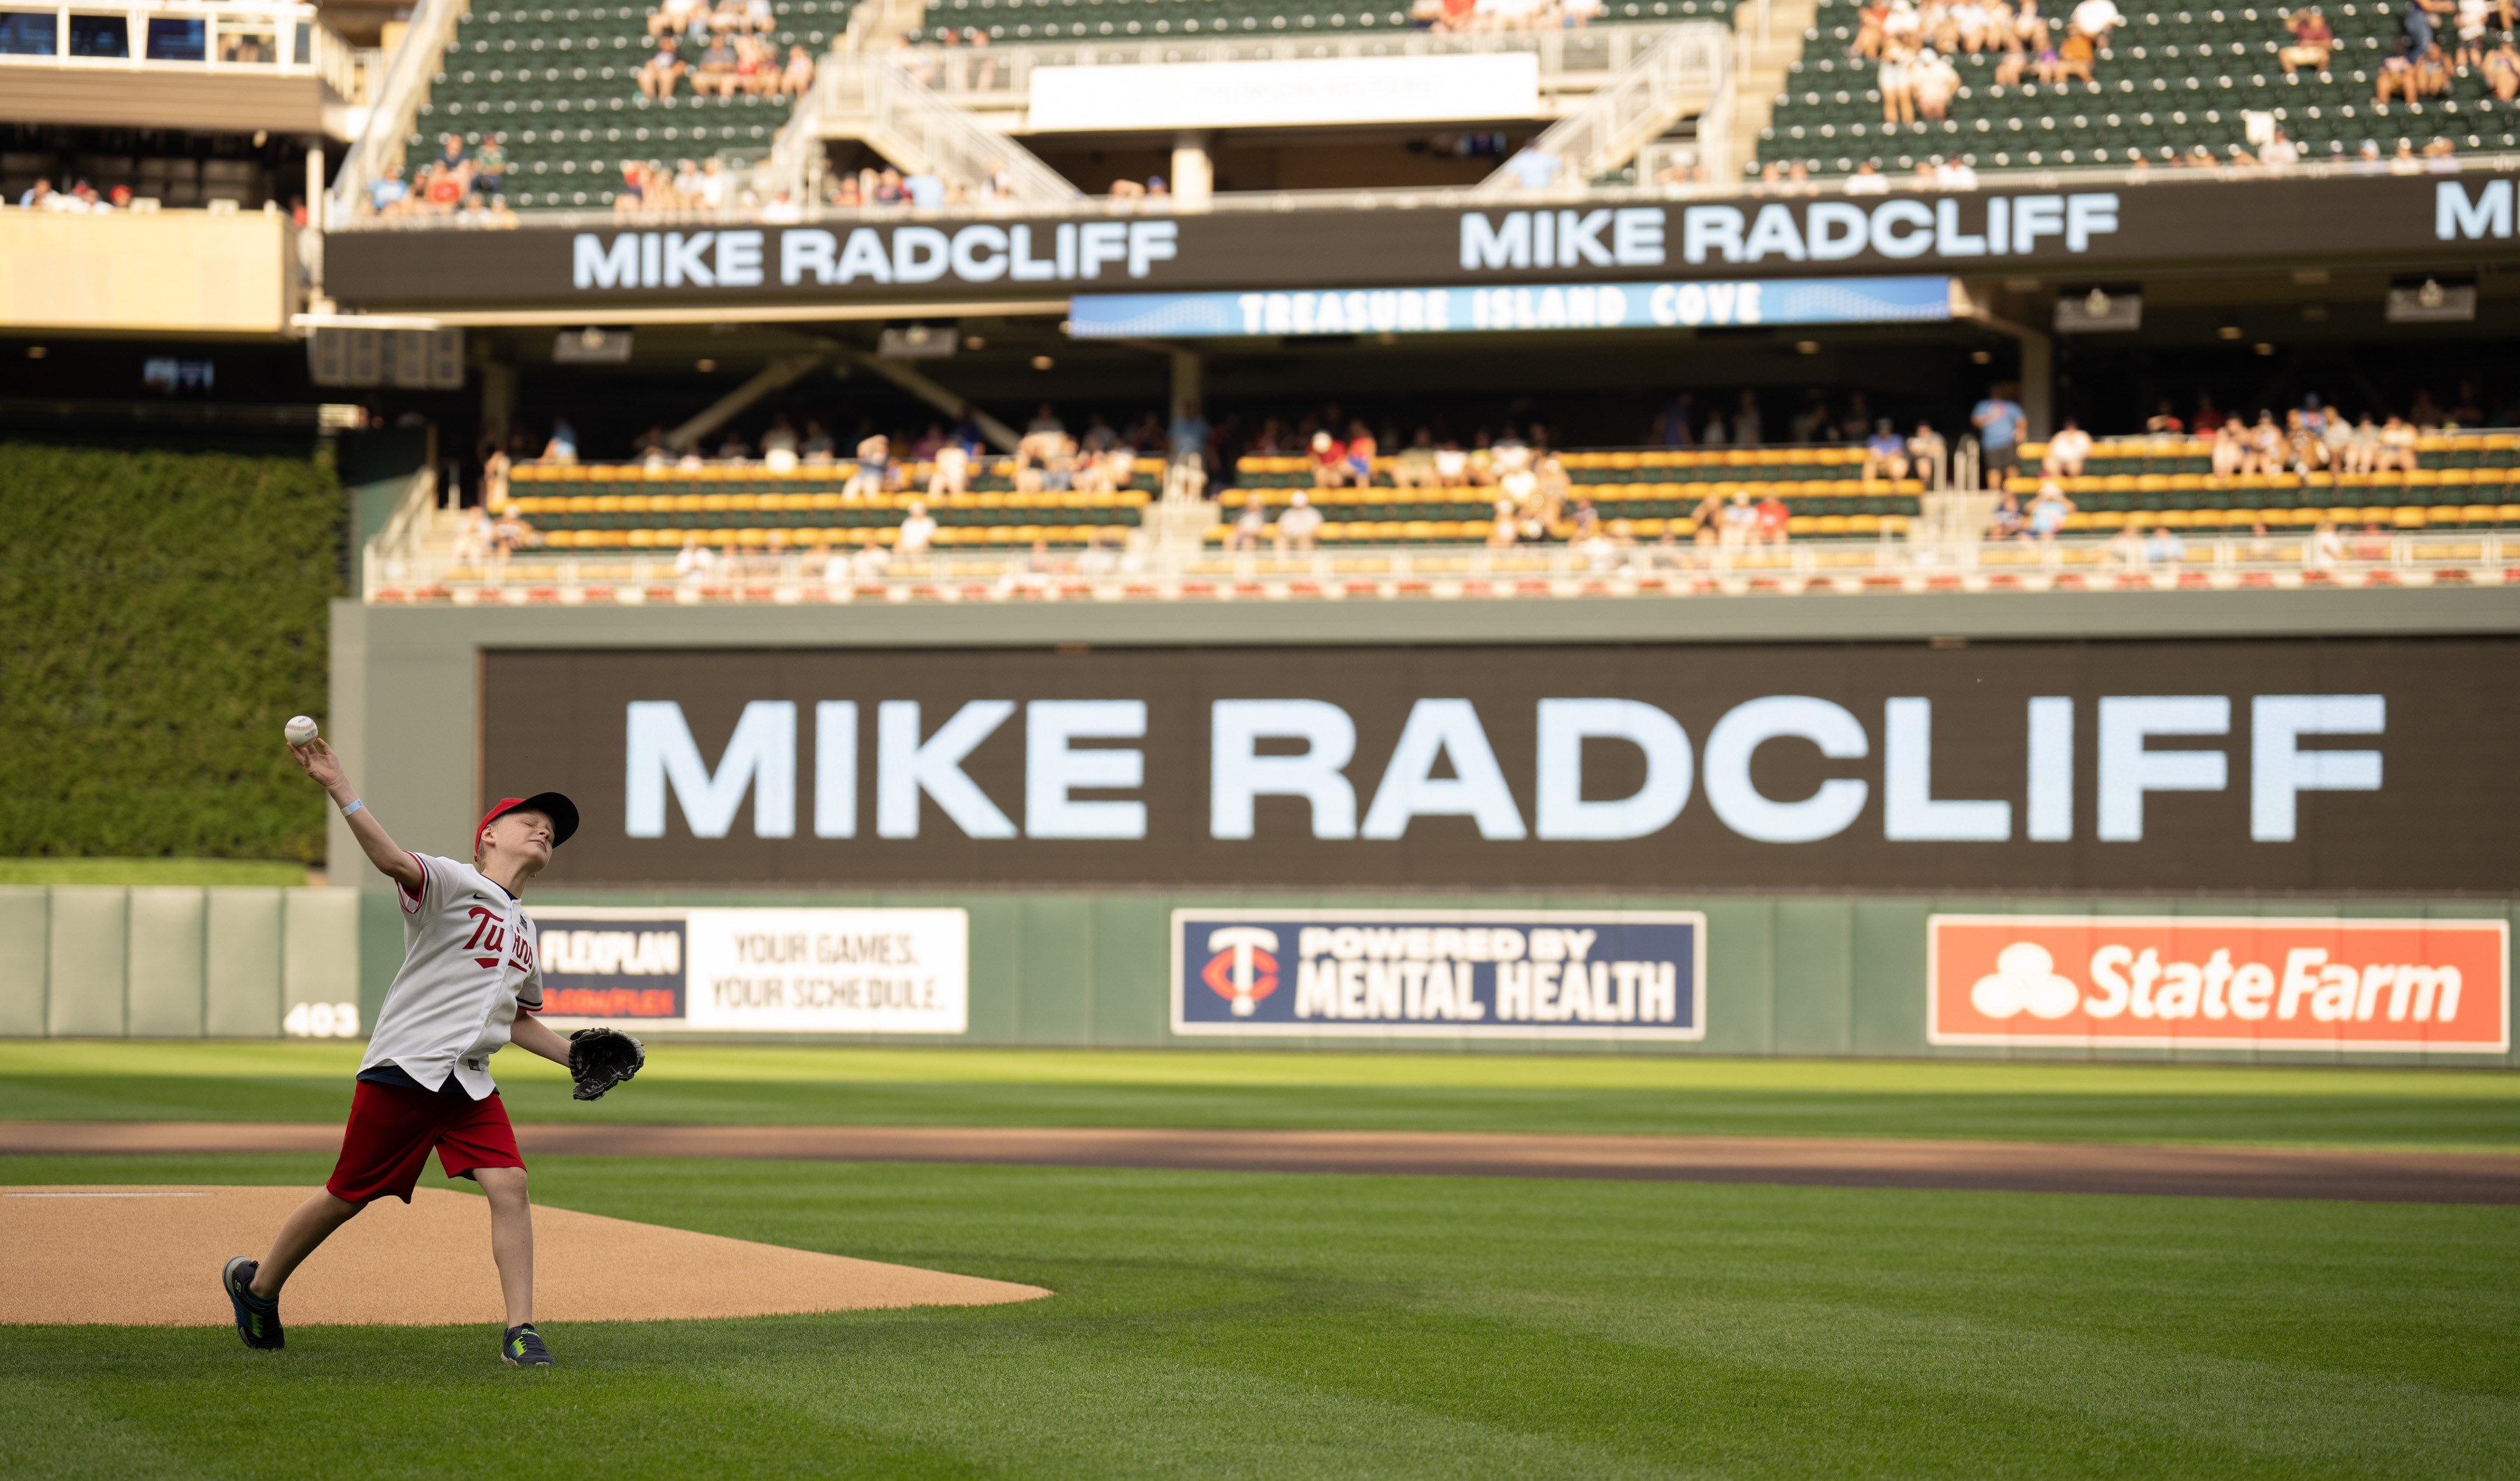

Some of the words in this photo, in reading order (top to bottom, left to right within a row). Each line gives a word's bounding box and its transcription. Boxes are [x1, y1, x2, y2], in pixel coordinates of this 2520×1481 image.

[1460, 208, 1666, 270] MIKE
[1683, 193, 2120, 264] RADCLIFF
[2435, 180, 2520, 240] M
[573, 231, 764, 288] MIKE
[780, 221, 1177, 285] RADCLIFF
[1239, 290, 1450, 333] TREASURE
[1471, 286, 1627, 329] ISLAND
[1649, 282, 1761, 325] COVE
[625, 699, 1147, 839] MIKE
[1210, 695, 2385, 843] RADCLIFF
[733, 933, 808, 965] YOUR
[816, 934, 919, 965] GAMES.
[1298, 927, 1526, 962] POWERED
[1529, 929, 1597, 962] BY
[710, 976, 785, 1009] YOUR
[792, 977, 948, 1011] SCHEDULE.
[1294, 960, 1485, 1019] MENTAL
[1495, 962, 1676, 1022] HEALTH
[283, 1002, 360, 1038] 403
